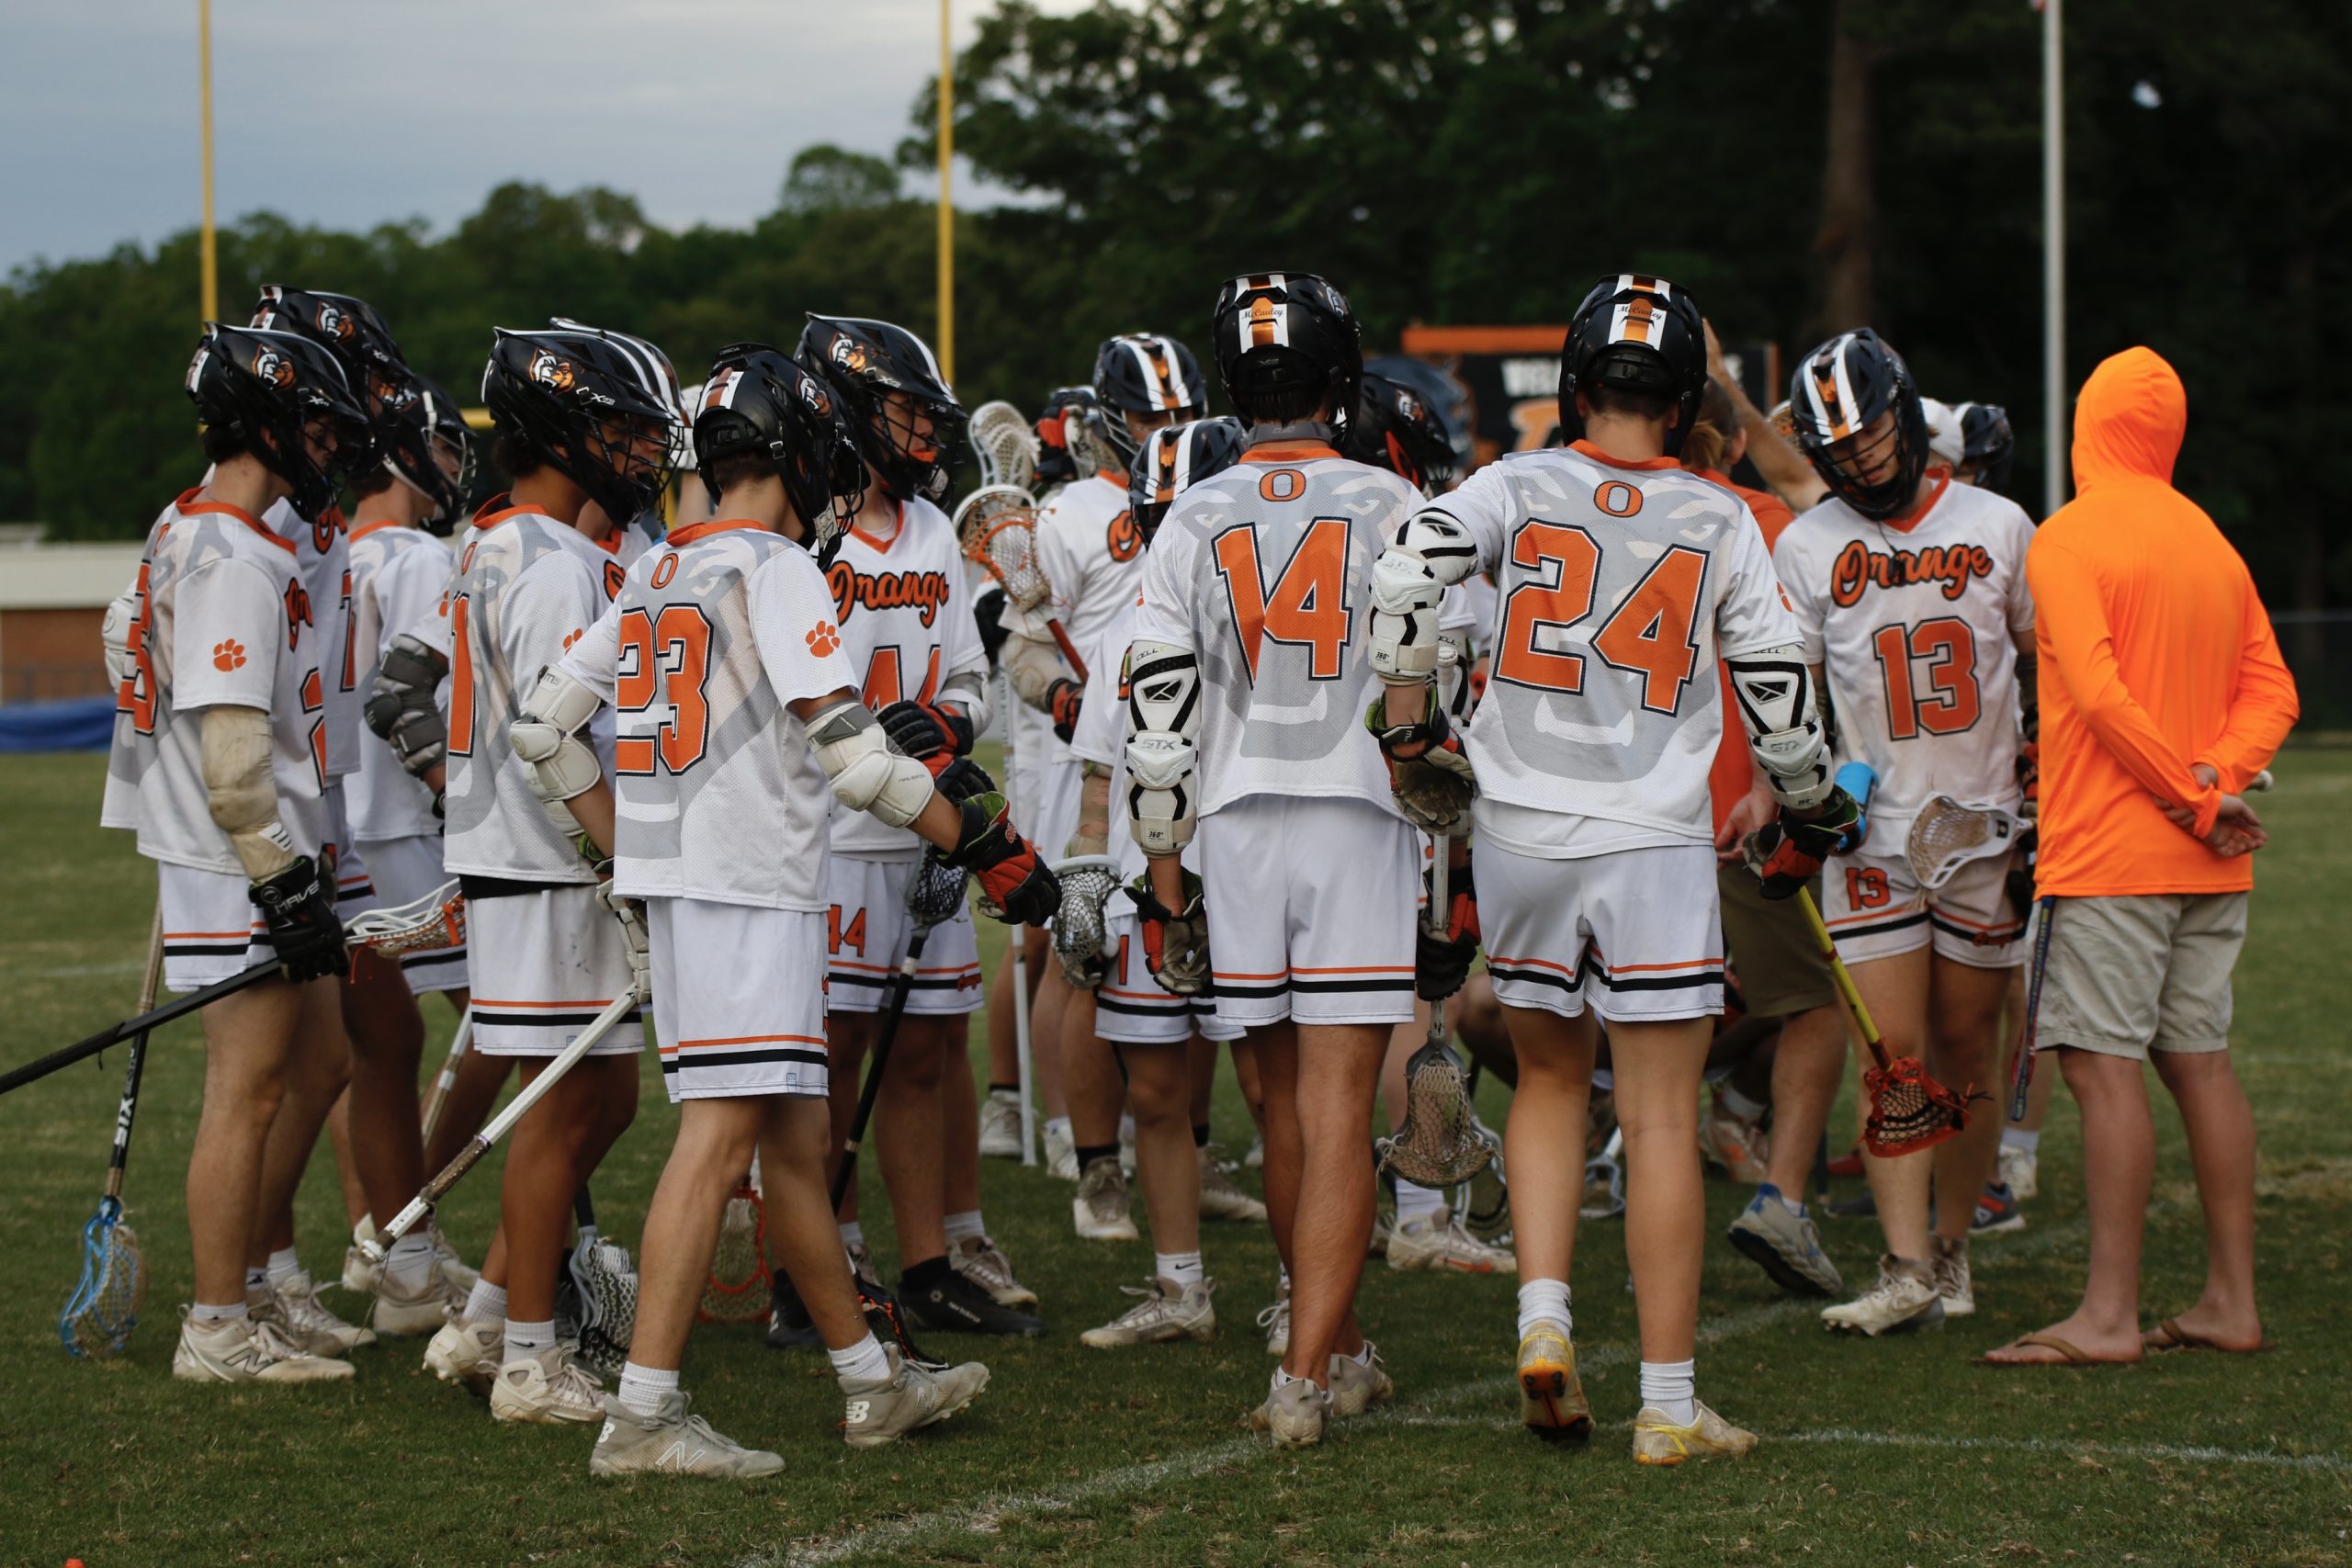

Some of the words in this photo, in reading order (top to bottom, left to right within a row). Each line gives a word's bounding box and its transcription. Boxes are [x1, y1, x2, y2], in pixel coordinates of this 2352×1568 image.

[1242, 307, 1283, 320] McCauley
[1618, 304, 1662, 320] McCauley
[1258, 468, 1306, 502] O
[1593, 480, 1644, 517] O
[650, 552, 679, 589] O
[1211, 516, 1352, 691] 14
[1492, 517, 1710, 718] 24
[616, 603, 715, 776] 23
[1872, 615, 1982, 741] 13
[1141, 739, 1177, 750] STX
[1846, 867, 1891, 911] 13
[827, 904, 866, 958] 44
